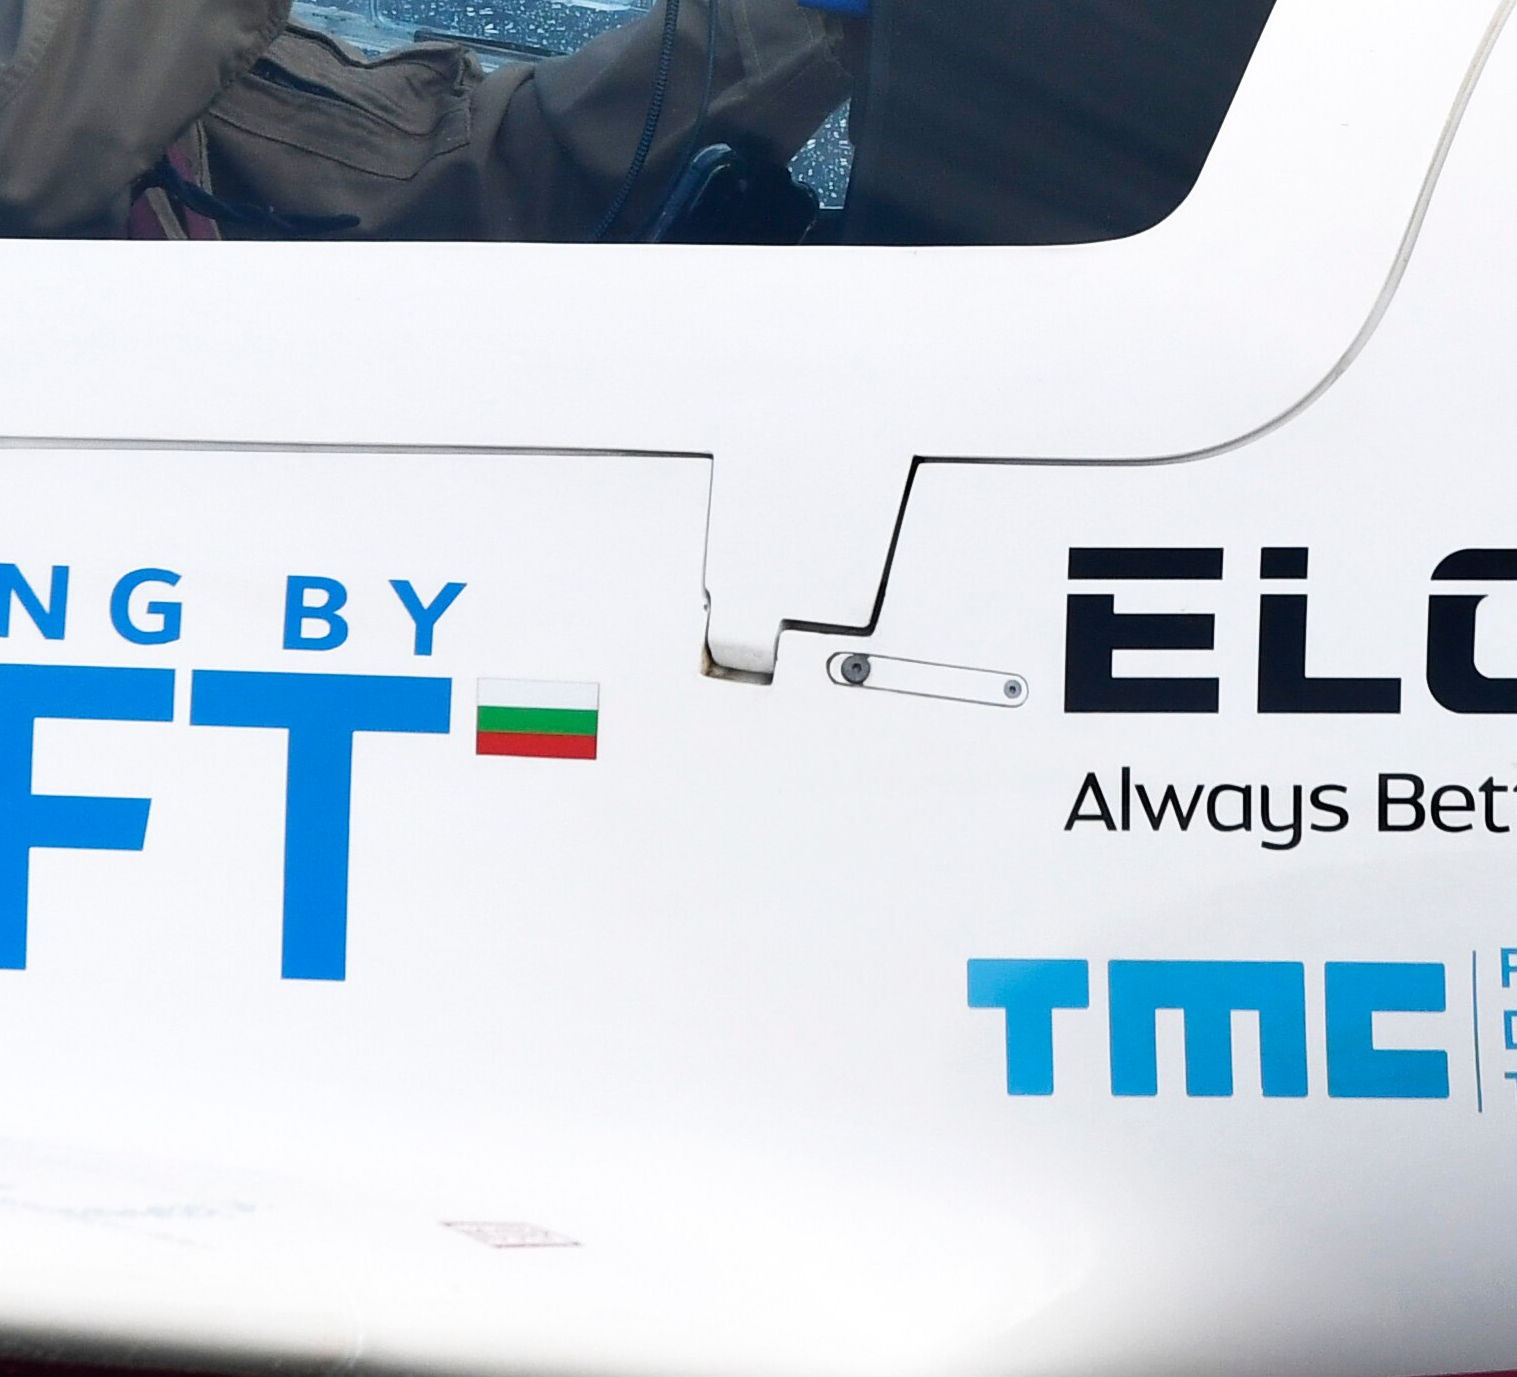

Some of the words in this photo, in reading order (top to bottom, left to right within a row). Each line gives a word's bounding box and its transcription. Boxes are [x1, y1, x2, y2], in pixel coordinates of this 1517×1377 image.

[281, 574, 468, 657] BY
[1063, 766, 1349, 851] Always
[967, 958, 1450, 1098] TMC
